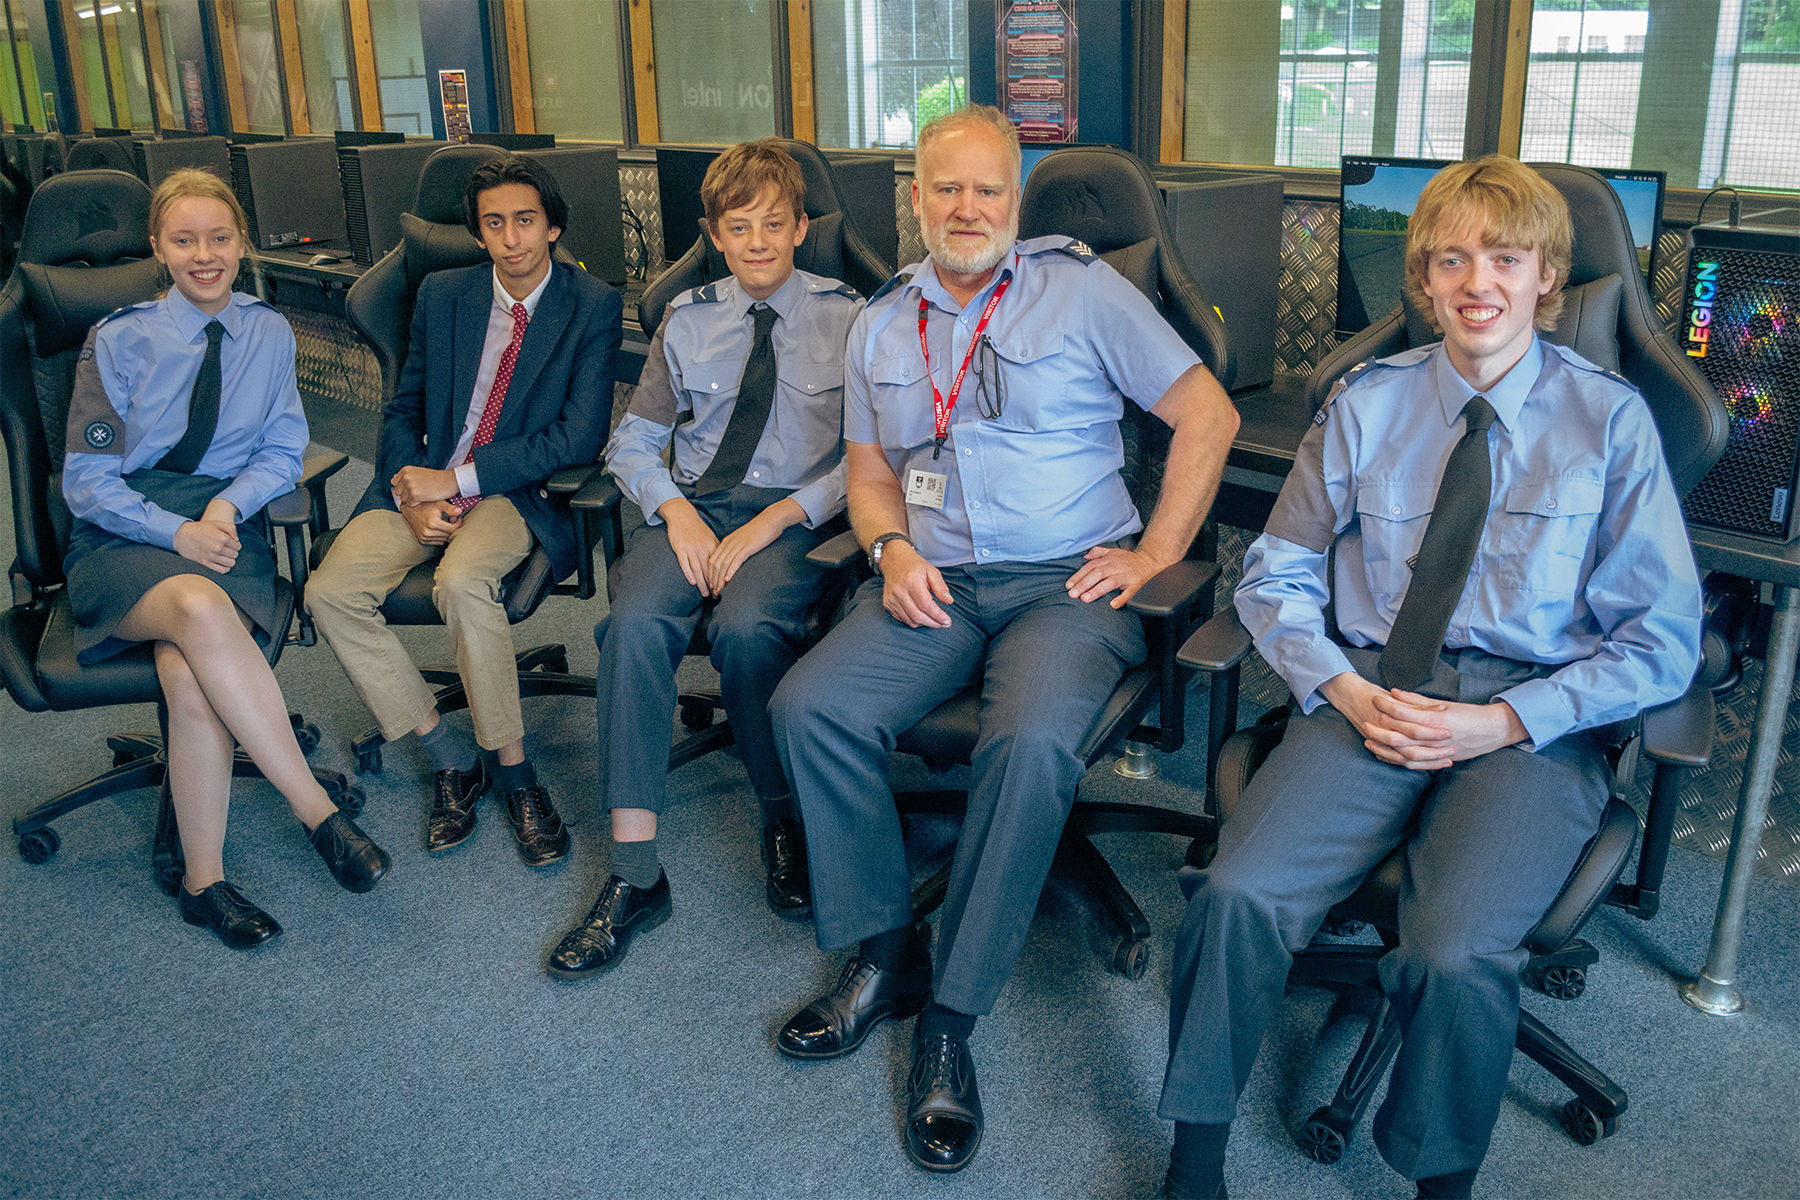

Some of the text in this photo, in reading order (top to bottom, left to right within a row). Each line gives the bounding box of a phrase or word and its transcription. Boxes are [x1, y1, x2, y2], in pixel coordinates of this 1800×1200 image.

[1686, 261, 1718, 358] LEGION
[940, 295, 1000, 433] VISITOR VISITOR VISITOR VISITOR
[1772, 491, 1785, 520] Lenovo
